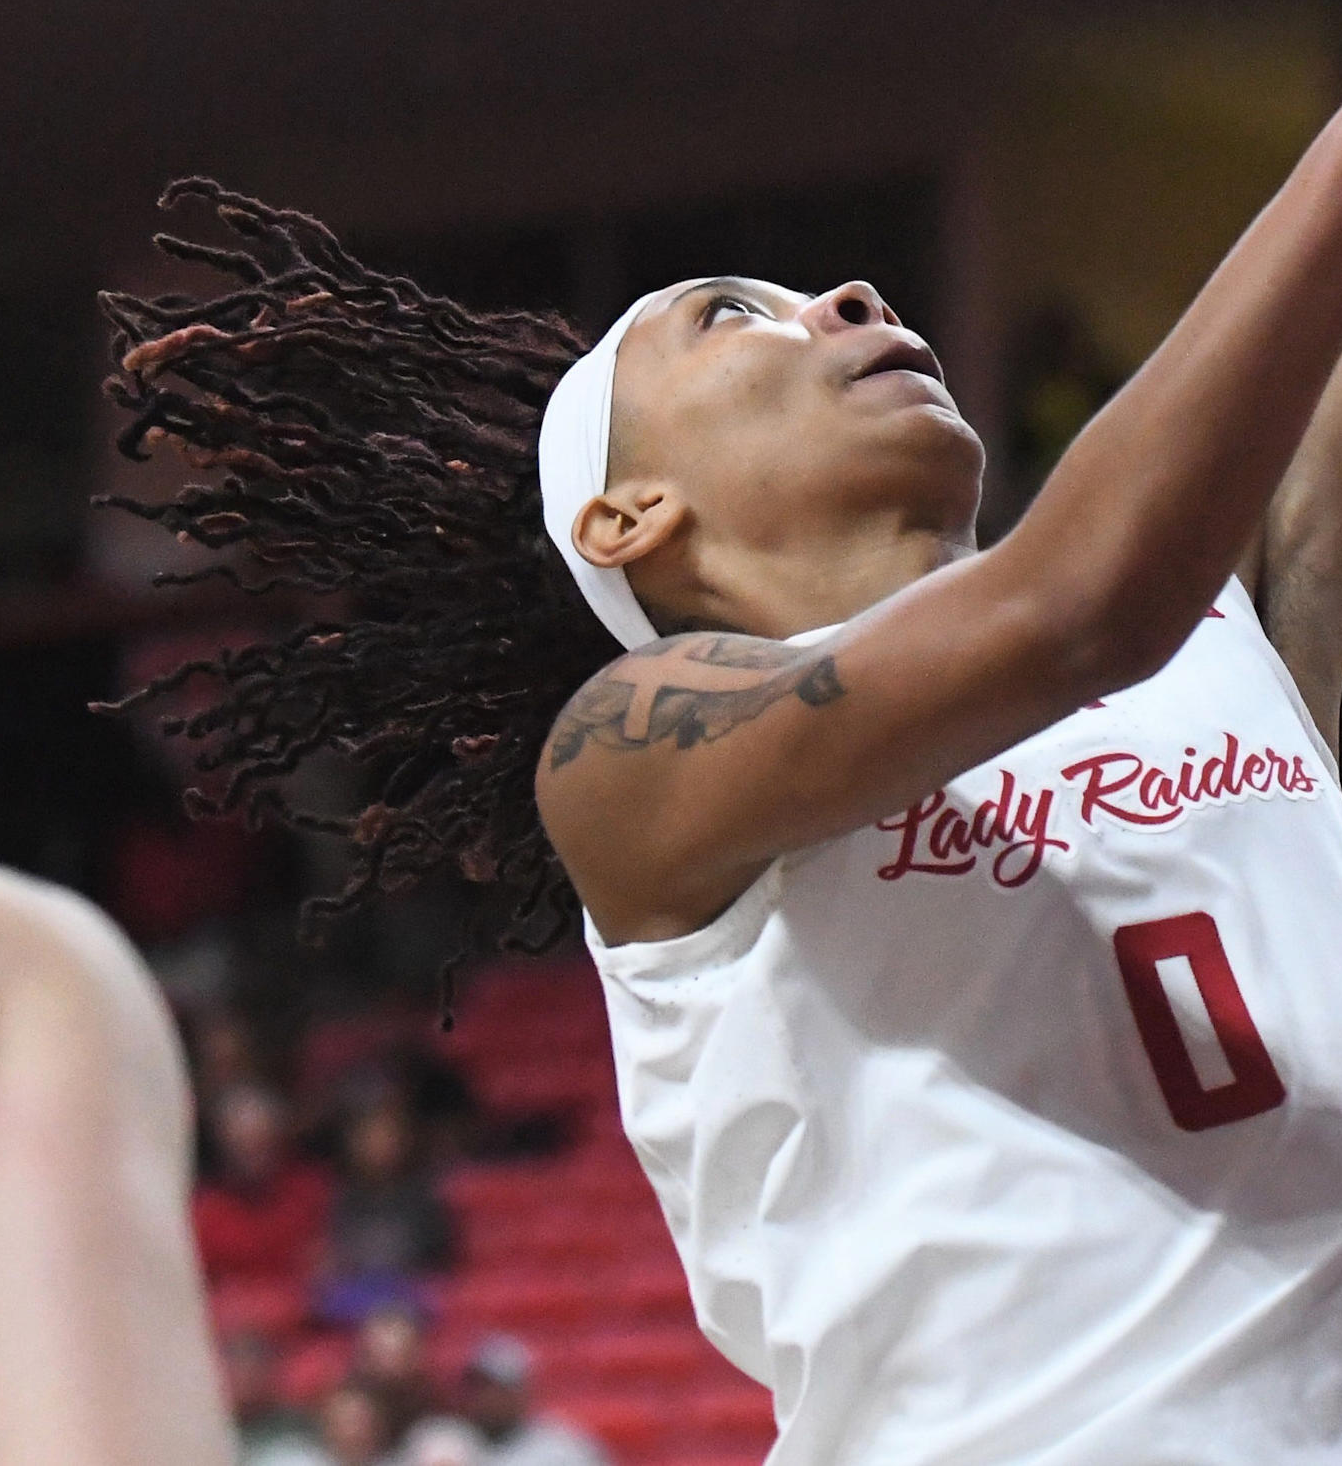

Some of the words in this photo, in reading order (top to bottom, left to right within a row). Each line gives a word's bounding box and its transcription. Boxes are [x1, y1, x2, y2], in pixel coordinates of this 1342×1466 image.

[876, 769, 1070, 888] Lady
[1061, 732, 1318, 825] Raiders
[1114, 911, 1287, 1131] 0
